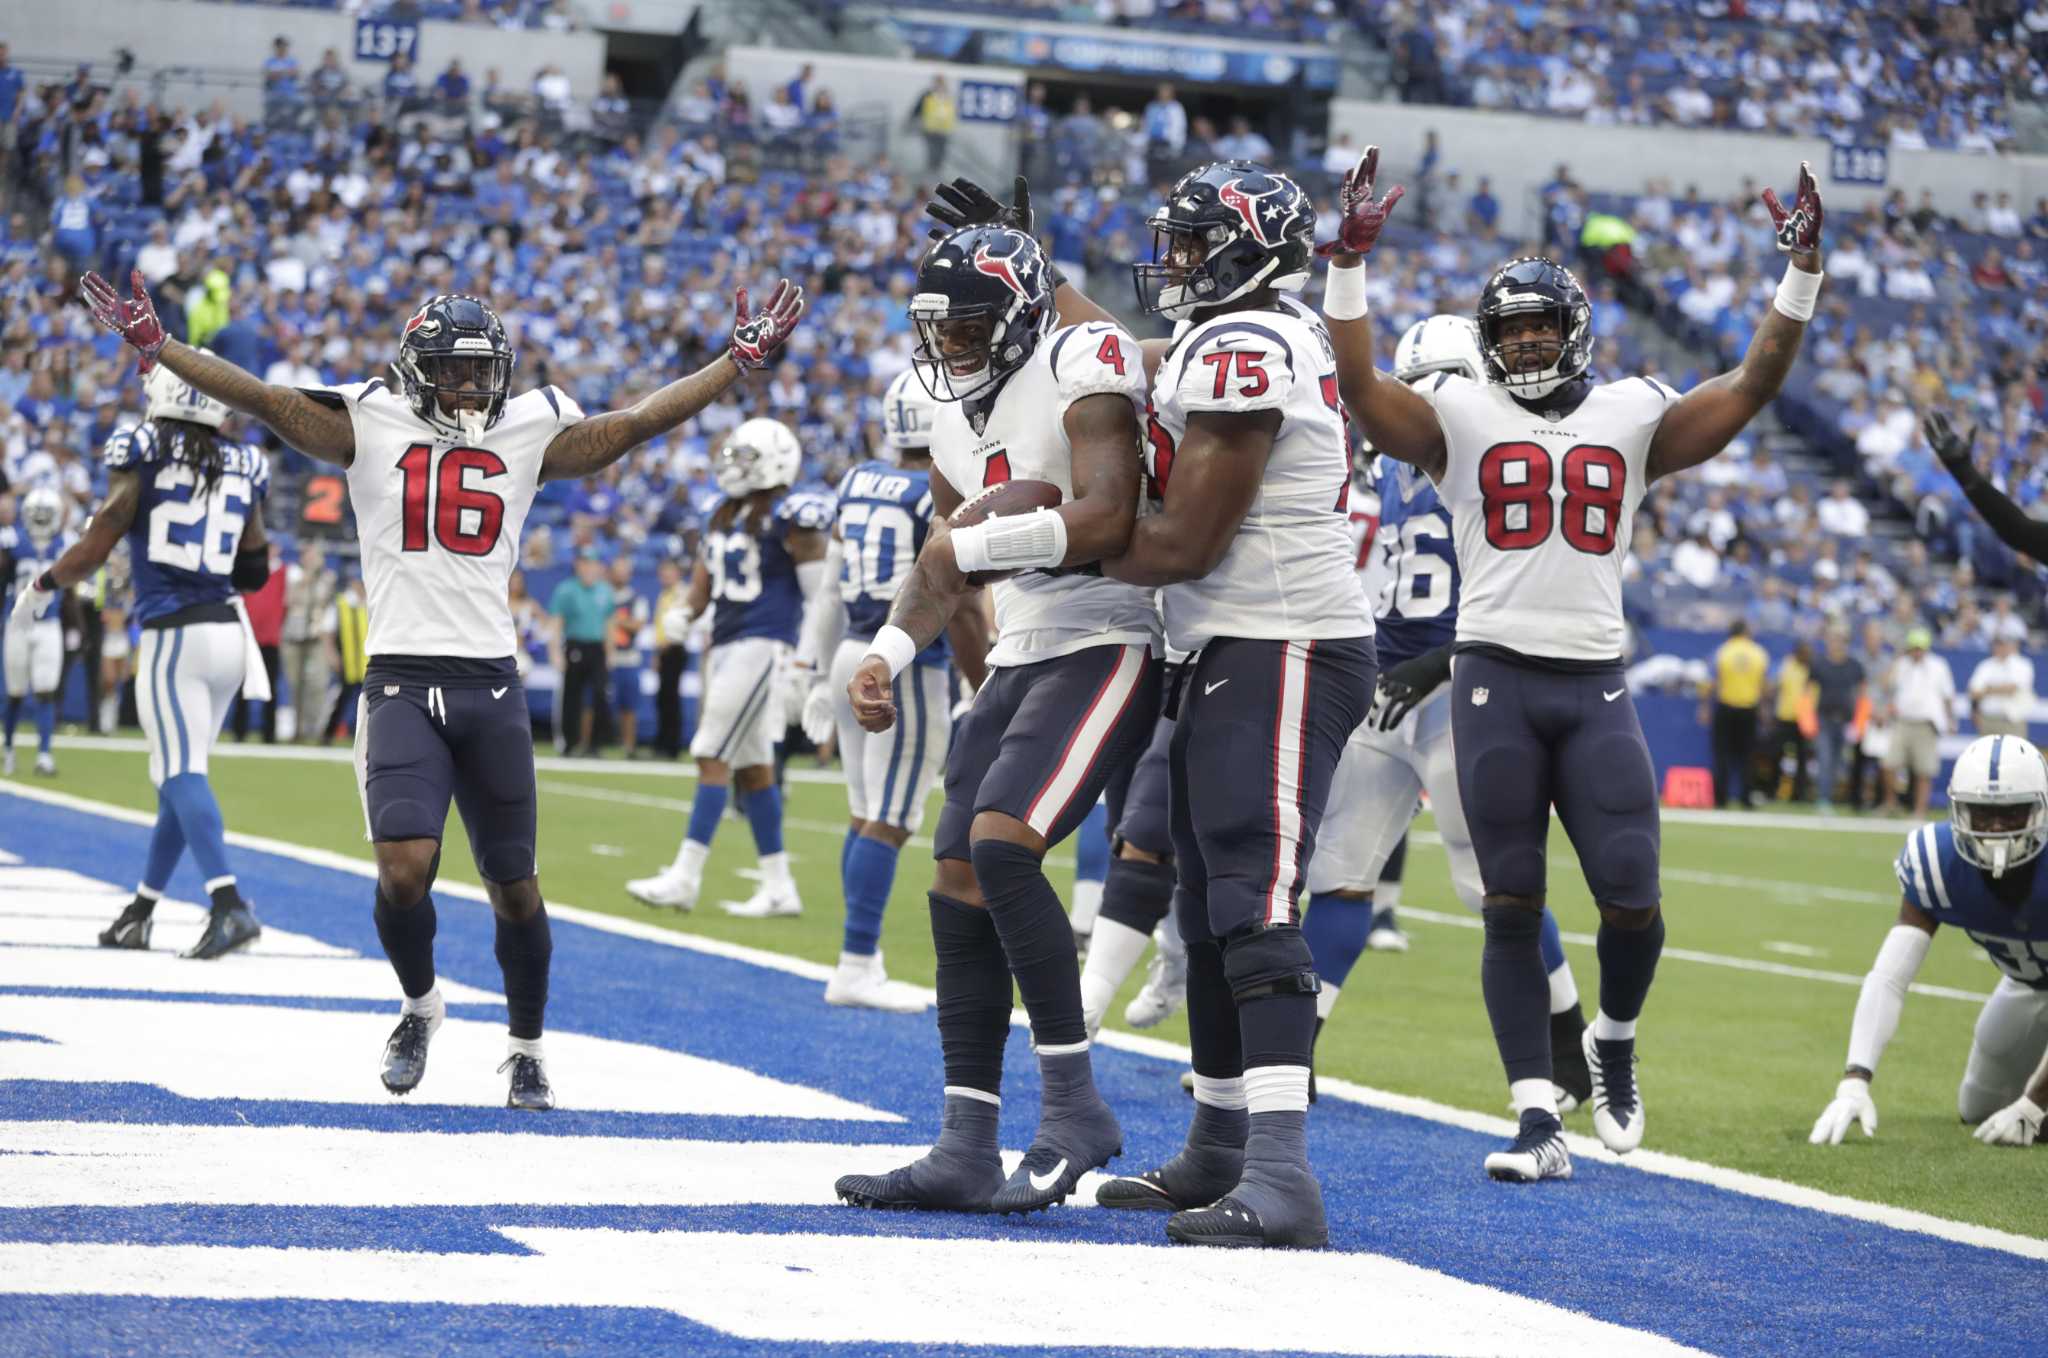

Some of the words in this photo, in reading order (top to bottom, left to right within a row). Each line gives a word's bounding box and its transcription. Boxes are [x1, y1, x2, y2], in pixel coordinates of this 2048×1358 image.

[360, 24, 415, 55] 137
[1096, 334, 1125, 376] 4
[1203, 351, 1269, 399] 75
[972, 440, 1001, 456] TEXANS
[1532, 429, 1578, 438] TEXANS
[147, 462, 252, 575] 26
[304, 475, 344, 524] 2
[395, 443, 508, 557] 16
[1478, 440, 1627, 556] 88
[840, 503, 915, 603] 50
